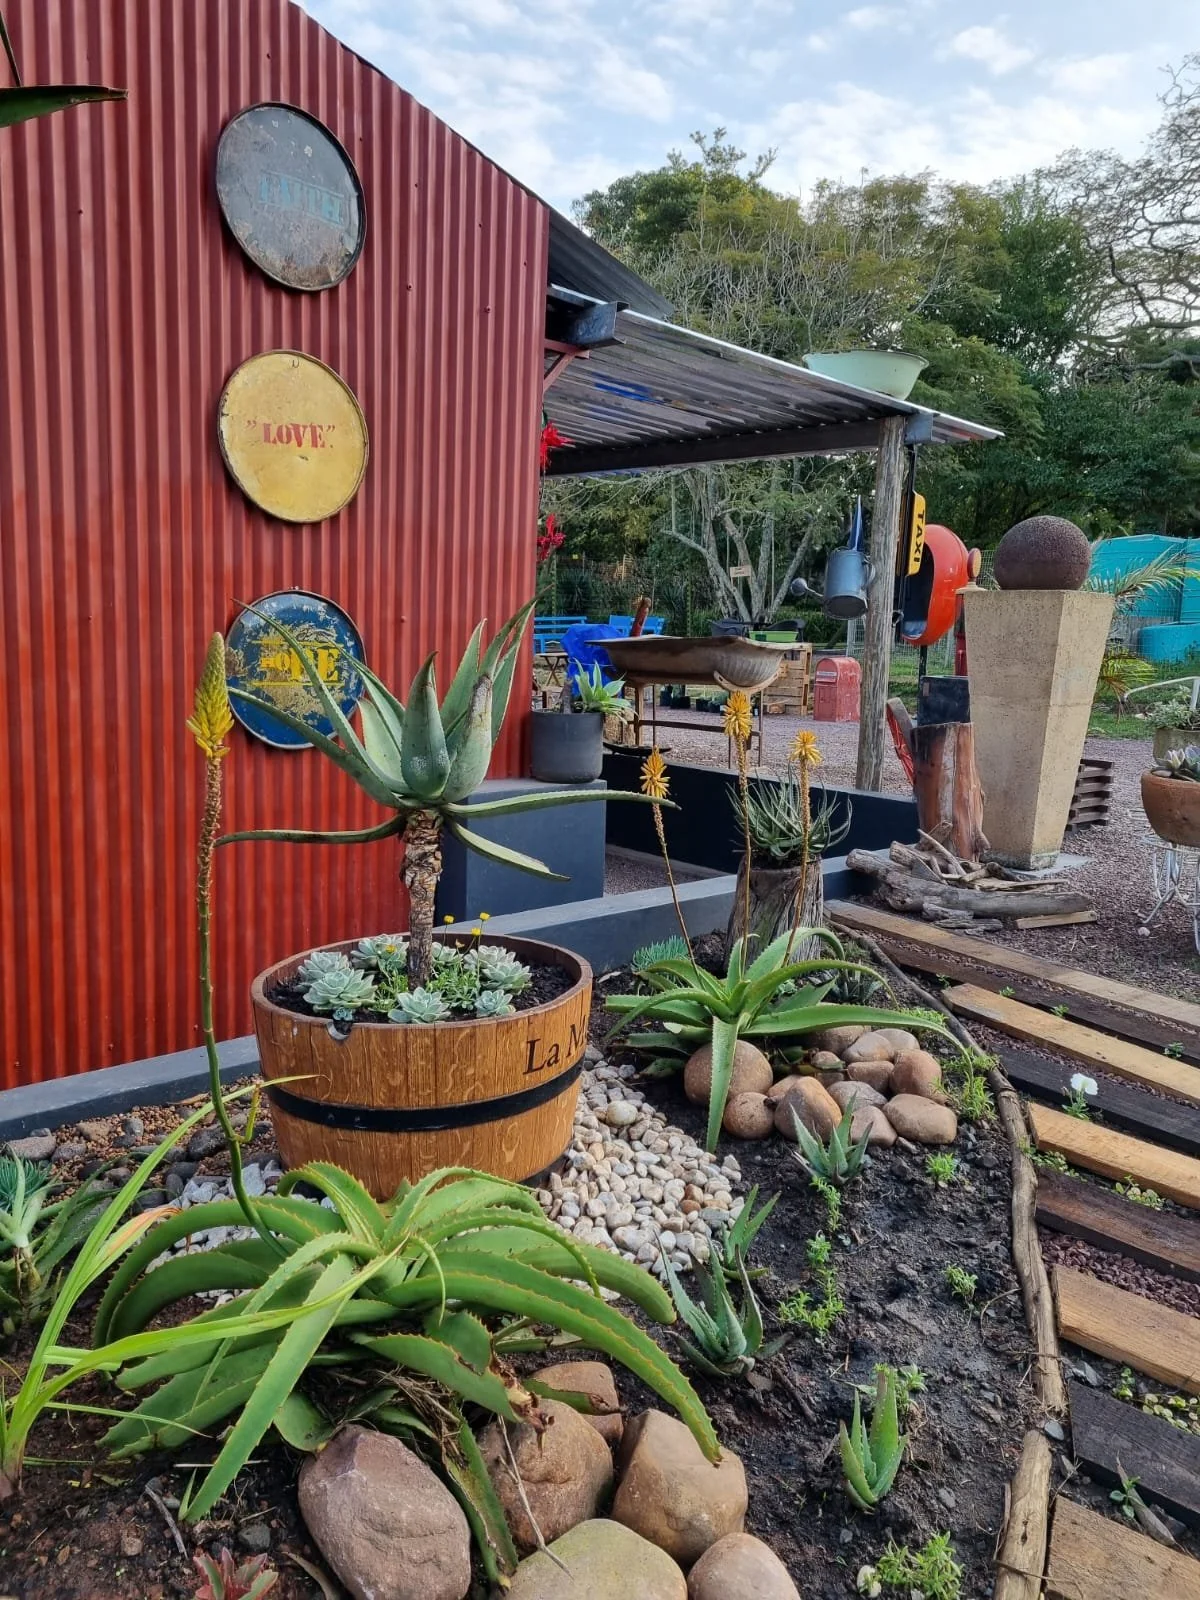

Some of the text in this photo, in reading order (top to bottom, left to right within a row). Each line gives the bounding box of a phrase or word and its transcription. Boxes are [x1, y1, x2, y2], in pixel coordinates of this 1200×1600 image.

[913, 509, 925, 563] TAXI
[522, 1014, 587, 1076] La M
